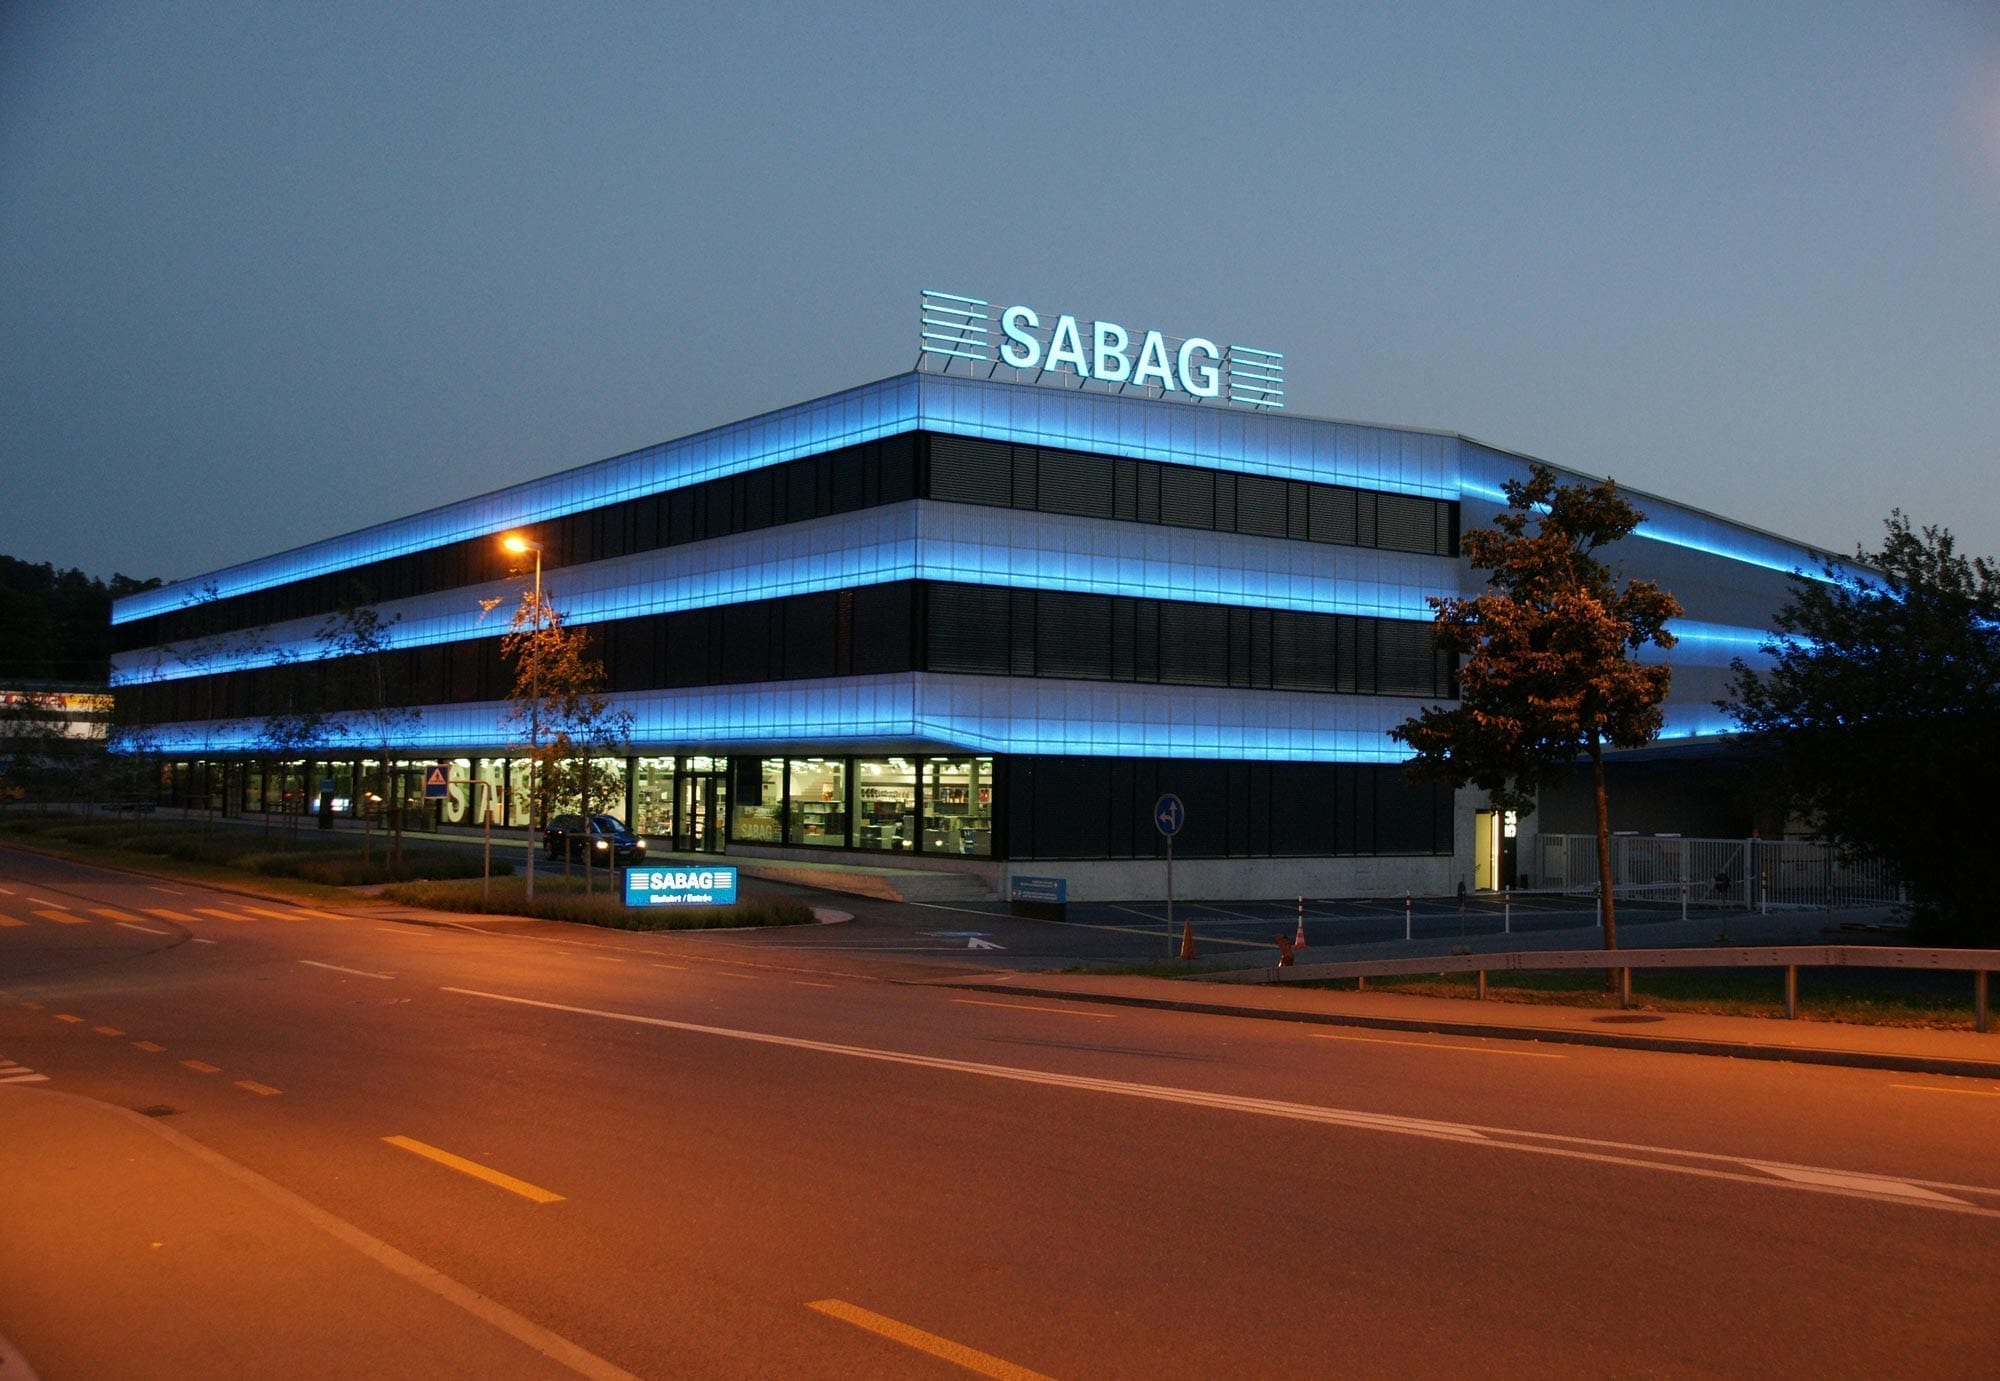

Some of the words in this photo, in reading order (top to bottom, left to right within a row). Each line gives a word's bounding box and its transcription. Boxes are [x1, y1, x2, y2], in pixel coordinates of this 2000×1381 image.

[999, 305, 1220, 398] SABAG
[740, 823, 773, 842] SABAG
[650, 872, 714, 890] SABAG
